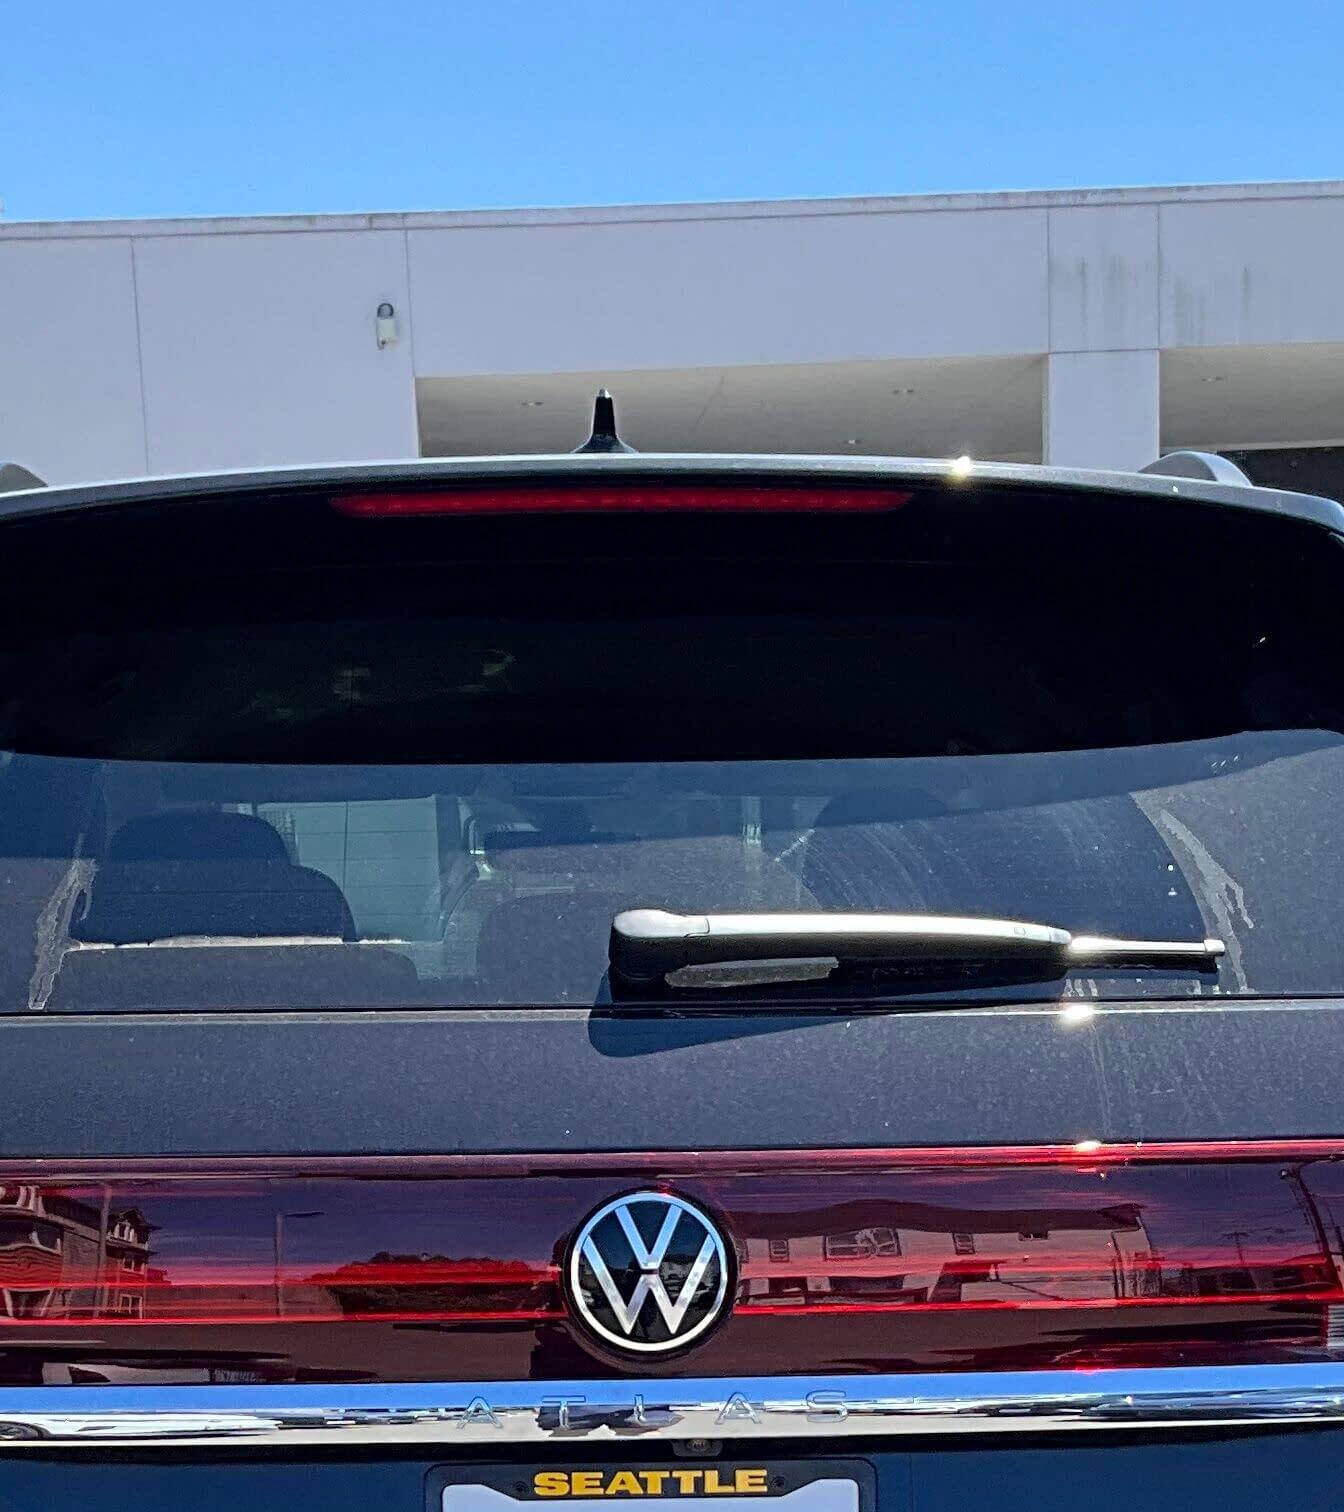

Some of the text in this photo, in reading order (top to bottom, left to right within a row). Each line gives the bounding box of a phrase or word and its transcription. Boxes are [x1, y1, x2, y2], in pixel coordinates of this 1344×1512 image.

[578, 1202, 718, 1336] VW
[456, 1390, 849, 1430] ATLAS
[534, 1469, 769, 1497] SEATTLE
